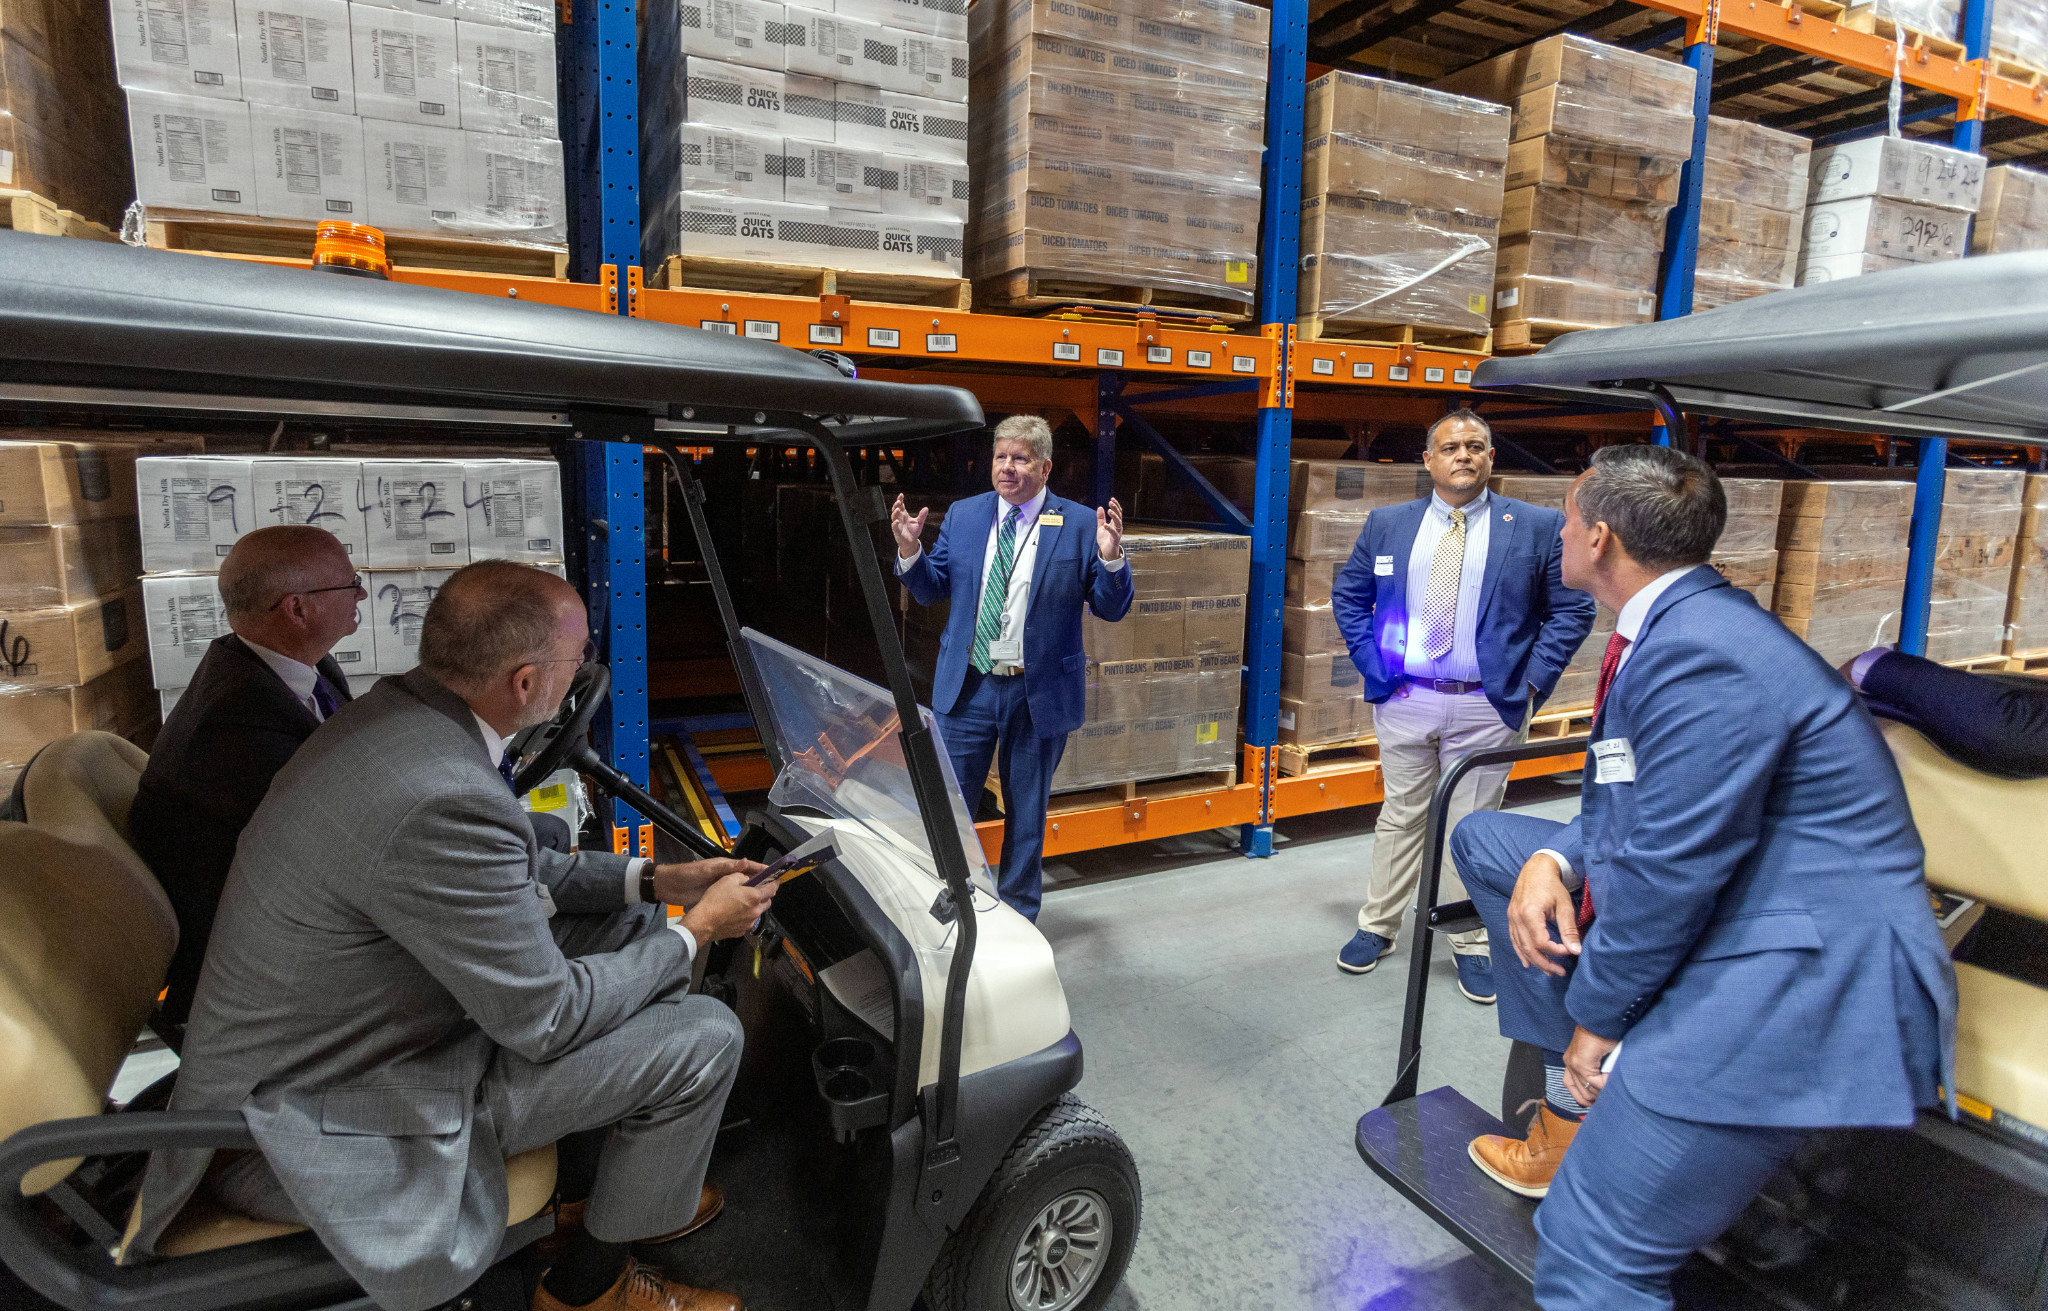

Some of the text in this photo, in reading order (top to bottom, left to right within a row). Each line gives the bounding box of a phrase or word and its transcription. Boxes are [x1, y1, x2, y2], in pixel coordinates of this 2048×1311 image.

[1051, 1, 1075, 16] DICED
[1077, 6, 1118, 27] TOMATOES
[137, 11, 147, 47] Nonfat Dry
[1140, 22, 1202, 45] DICED TOMATOES
[1037, 39, 1106, 63] DICED TOMATOES
[1230, 41, 1266, 59] TOMATOES
[1113, 56, 1177, 78] DICED TOMATOES
[1306, 75, 1330, 93] BEANS
[1338, 73, 1376, 90] PINTO BEANS
[749, 88, 778, 99] QUICK
[1048, 80, 1072, 96] DICED
[1073, 86, 1115, 104] TOMATOES
[747, 96, 780, 111] OATS
[1134, 99, 1197, 119] DICED TOMATOES
[153, 114, 161, 128] Milk
[892, 111, 918, 121] QUICK
[890, 119, 920, 133] OATS
[1034, 118, 1103, 140] DICED TOMATOES
[155, 130, 164, 144] Dry
[1309, 136, 1328, 150] BEANS
[275, 143, 283, 156] Dry
[1045, 158, 1069, 172] DICED
[1071, 162, 1112, 179] TOMATOES
[1132, 172, 1154, 186] DICED
[1031, 195, 1055, 209] DICED
[1057, 199, 1099, 214] TOMATOES
[1328, 196, 1366, 210] PINTO BEANS
[1372, 202, 1407, 216] PINTO BEANS
[1106, 206, 1169, 223] DICED TOMATOES
[743, 218, 772, 227] QUICK
[1186, 217, 1244, 234] DICED TOMATOES
[1455, 215, 1496, 229] PINTO BEANS
[741, 226, 774, 239] OATS
[885, 233, 911, 242] QUICK
[883, 241, 913, 253] OATS
[1042, 234, 1108, 252] DICED TOMATOES
[1129, 244, 1190, 262] DICED TOMATOES
[1196, 253, 1218, 265] DICED
[162, 494, 171, 507] Dry
[163, 508, 171, 529] Nonfat
[1209, 540, 1248, 550] PINTO BEANS
[1140, 601, 1182, 613] PINTO BEANS
[1191, 598, 1241, 610] PINTO BEANS
[168, 597, 180, 647] Nonfat Dry Milk
[1154, 659, 1195, 672] PINTO BEANS
[1200, 654, 1240, 667] PINTO BEANS
[1104, 665, 1124, 676] PINTO
[1125, 663, 1147, 673] BEANS
[1183, 711, 1234, 726] PINTO BEANS
[1082, 725, 1126, 738] PINTO BEANS
[1134, 720, 1176, 732] PINTO BEANS
